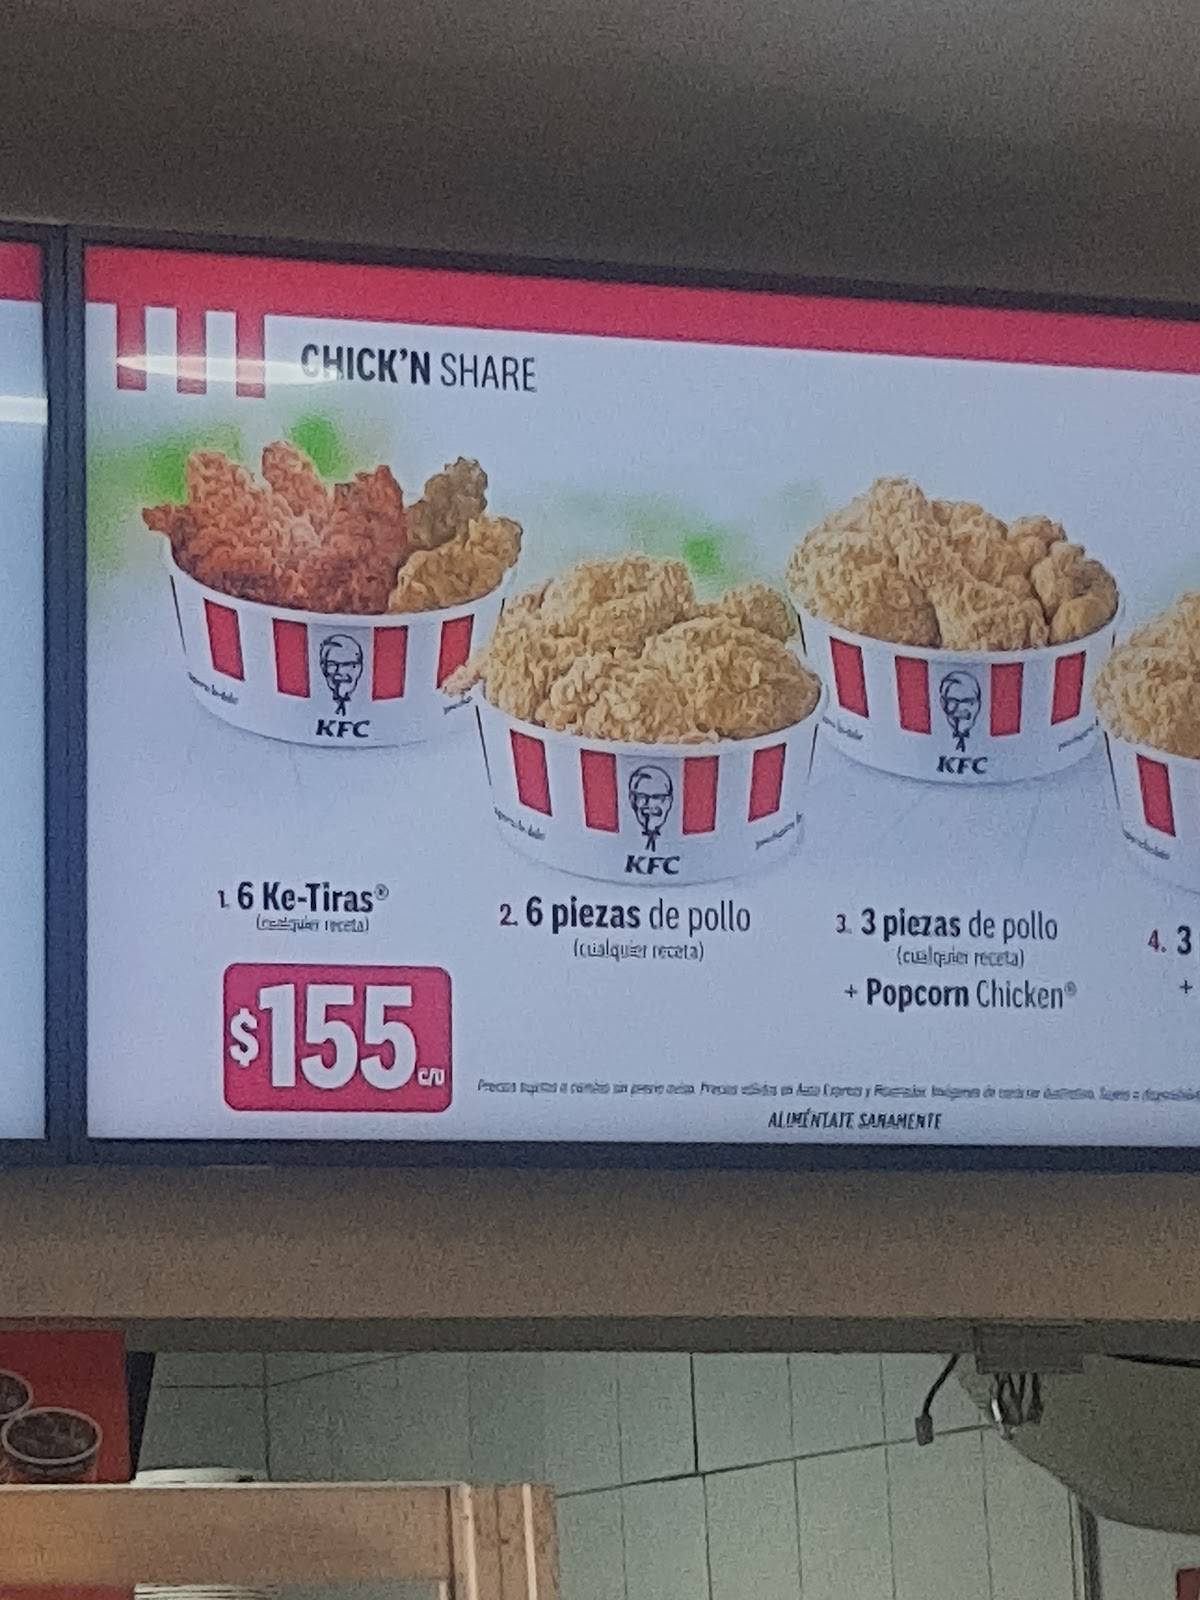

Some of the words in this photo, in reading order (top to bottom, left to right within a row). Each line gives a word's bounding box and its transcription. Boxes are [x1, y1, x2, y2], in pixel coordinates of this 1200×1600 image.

[440, 352, 538, 393] SHARE
[315, 719, 371, 738] KFC
[936, 755, 989, 775] KFC
[624, 854, 681, 875] KFC
[237, 881, 254, 911] 6
[526, 896, 543, 927] 6
[552, 896, 641, 935] piezas
[649, 898, 680, 931] de
[688, 900, 751, 938] pollo
[860, 908, 876, 936] 3
[882, 907, 961, 942] piezas
[968, 909, 995, 939] de
[1003, 910, 1059, 944] pollo
[1147, 928, 1167, 952] 4.
[1177, 924, 1192, 956] 3
[866, 977, 970, 1013] Popcorn
[229, 983, 417, 1091] $155
